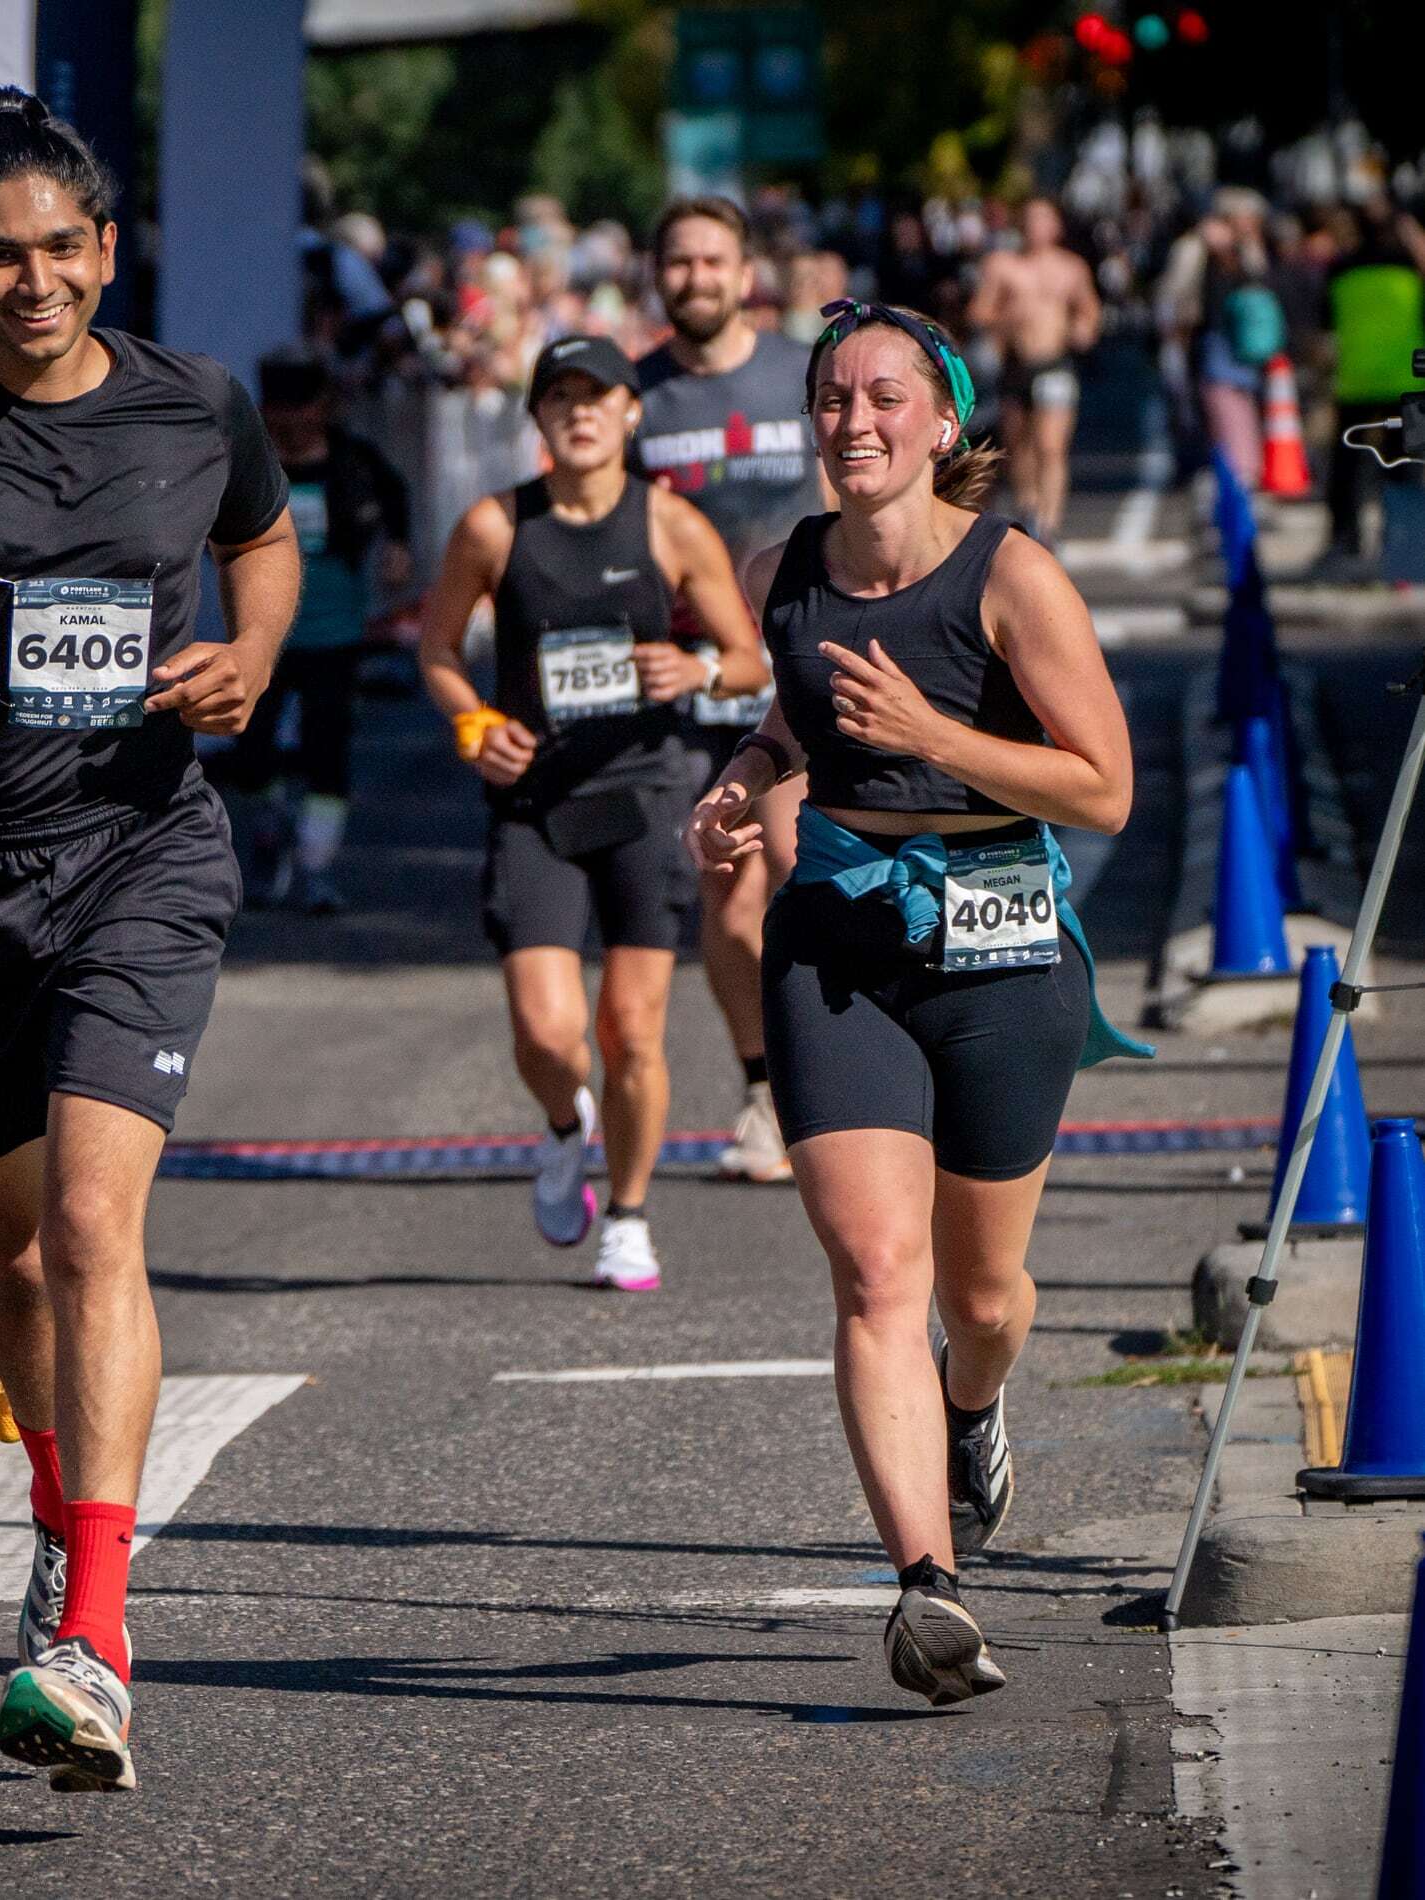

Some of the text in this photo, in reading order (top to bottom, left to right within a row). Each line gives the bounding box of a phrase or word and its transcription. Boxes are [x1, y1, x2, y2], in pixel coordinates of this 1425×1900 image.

[60, 615, 106, 625] KAMAL
[17, 633, 144, 671] 6406
[550, 661, 632, 695] 7859
[90, 717, 114, 727] BEER
[983, 874, 1021, 889] MEGAN
[951, 888, 1052, 933] 4040
